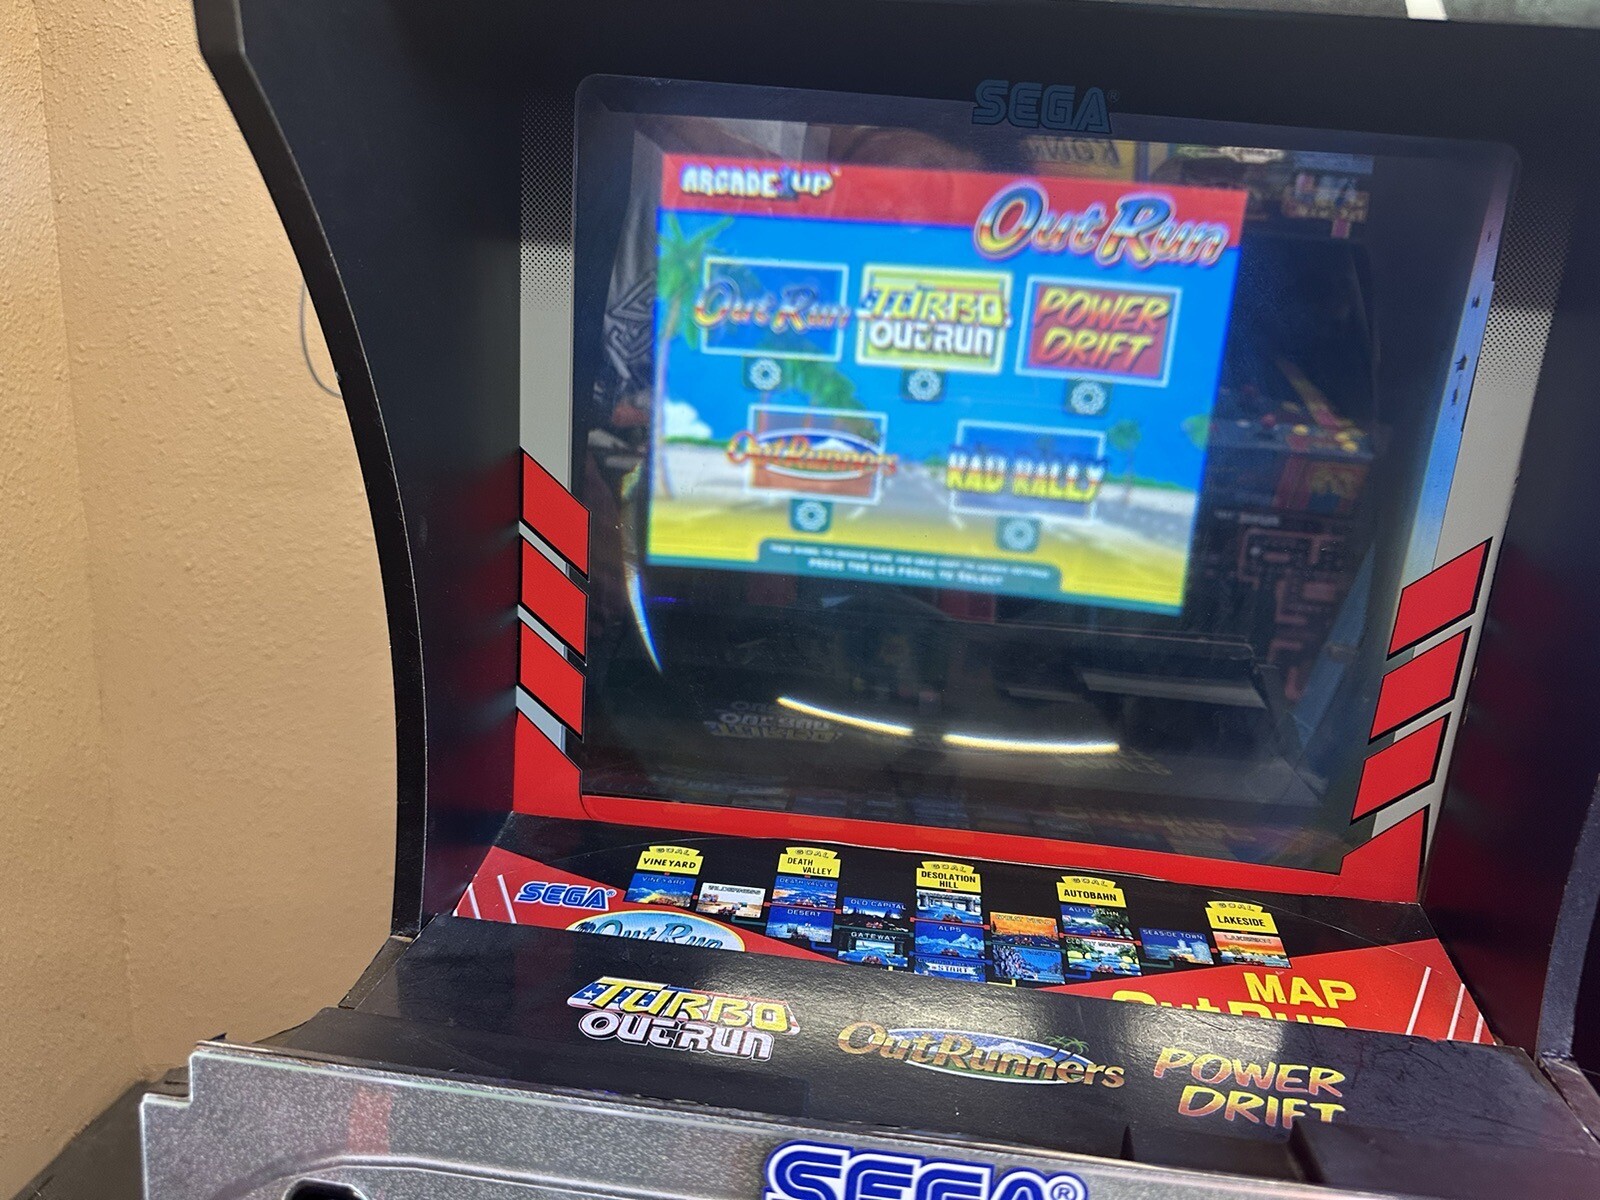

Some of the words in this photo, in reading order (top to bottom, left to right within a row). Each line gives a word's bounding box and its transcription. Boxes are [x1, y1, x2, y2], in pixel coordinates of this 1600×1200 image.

[971, 78, 1112, 134] SEGA
[867, 280, 1007, 327] TURBO
[1034, 287, 1172, 330] POWER
[1041, 327, 1157, 372] DRIFT
[642, 857, 697, 869] VINEYARD
[787, 856, 814, 867] DEATH
[802, 866, 833, 876] VALLEY
[920, 870, 976, 884] DESOLATION
[778, 877, 804, 887] DEATH
[806, 879, 834, 889] VALLEY
[939, 879, 959, 889] HILL
[516, 881, 610, 911] SEGA
[1063, 889, 1118, 902] AUTOBAHN
[850, 899, 869, 907] OLD
[870, 899, 907, 912] CAPITAL
[1068, 906, 1120, 917] AUTOBAHN
[786, 908, 822, 918] DESERT
[1216, 915, 1266, 927] LAKESIDE
[850, 930, 897, 942] GATEWAY
[937, 925, 962, 934] ALPS
[1180, 932, 1203, 941] TOWN
[1242, 972, 1357, 1009] MAP
[590, 976, 789, 1032] TURBO
[837, 1021, 1126, 1089] OutRunners
[1153, 1047, 1346, 1098] POWER
[1178, 1085, 1346, 1130] DRIFT
